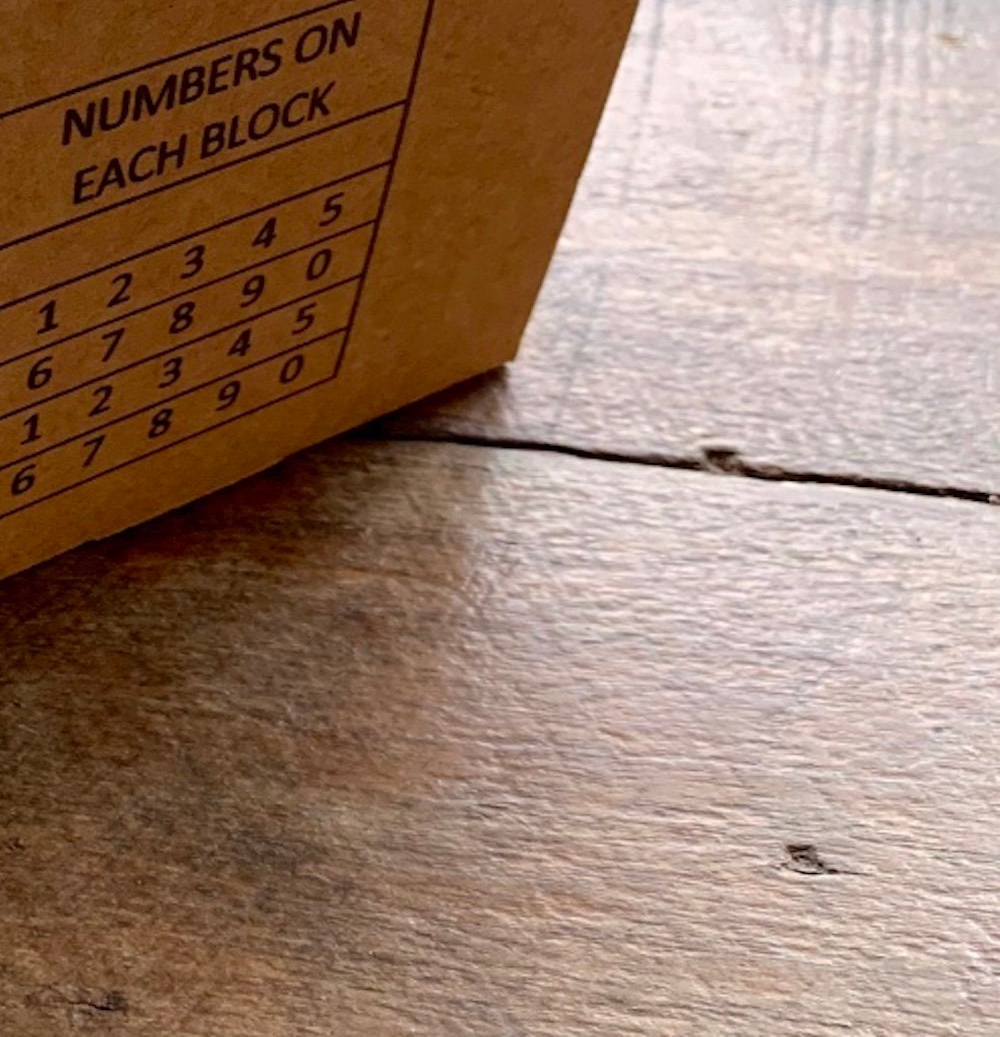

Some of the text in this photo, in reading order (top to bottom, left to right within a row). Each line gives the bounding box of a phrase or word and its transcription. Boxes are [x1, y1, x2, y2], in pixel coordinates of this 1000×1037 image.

[61, 11, 362, 146] NUMBERS ON
[73, 81, 335, 205] EACH BLOCK
[27, 248, 332, 390] 6 7 8 9 0
[36, 192, 345, 335] 1 2 3 4 5
[11, 354, 304, 496] 6 7 8 9 0
[20, 302, 317, 445] 1 2 3 4 5
